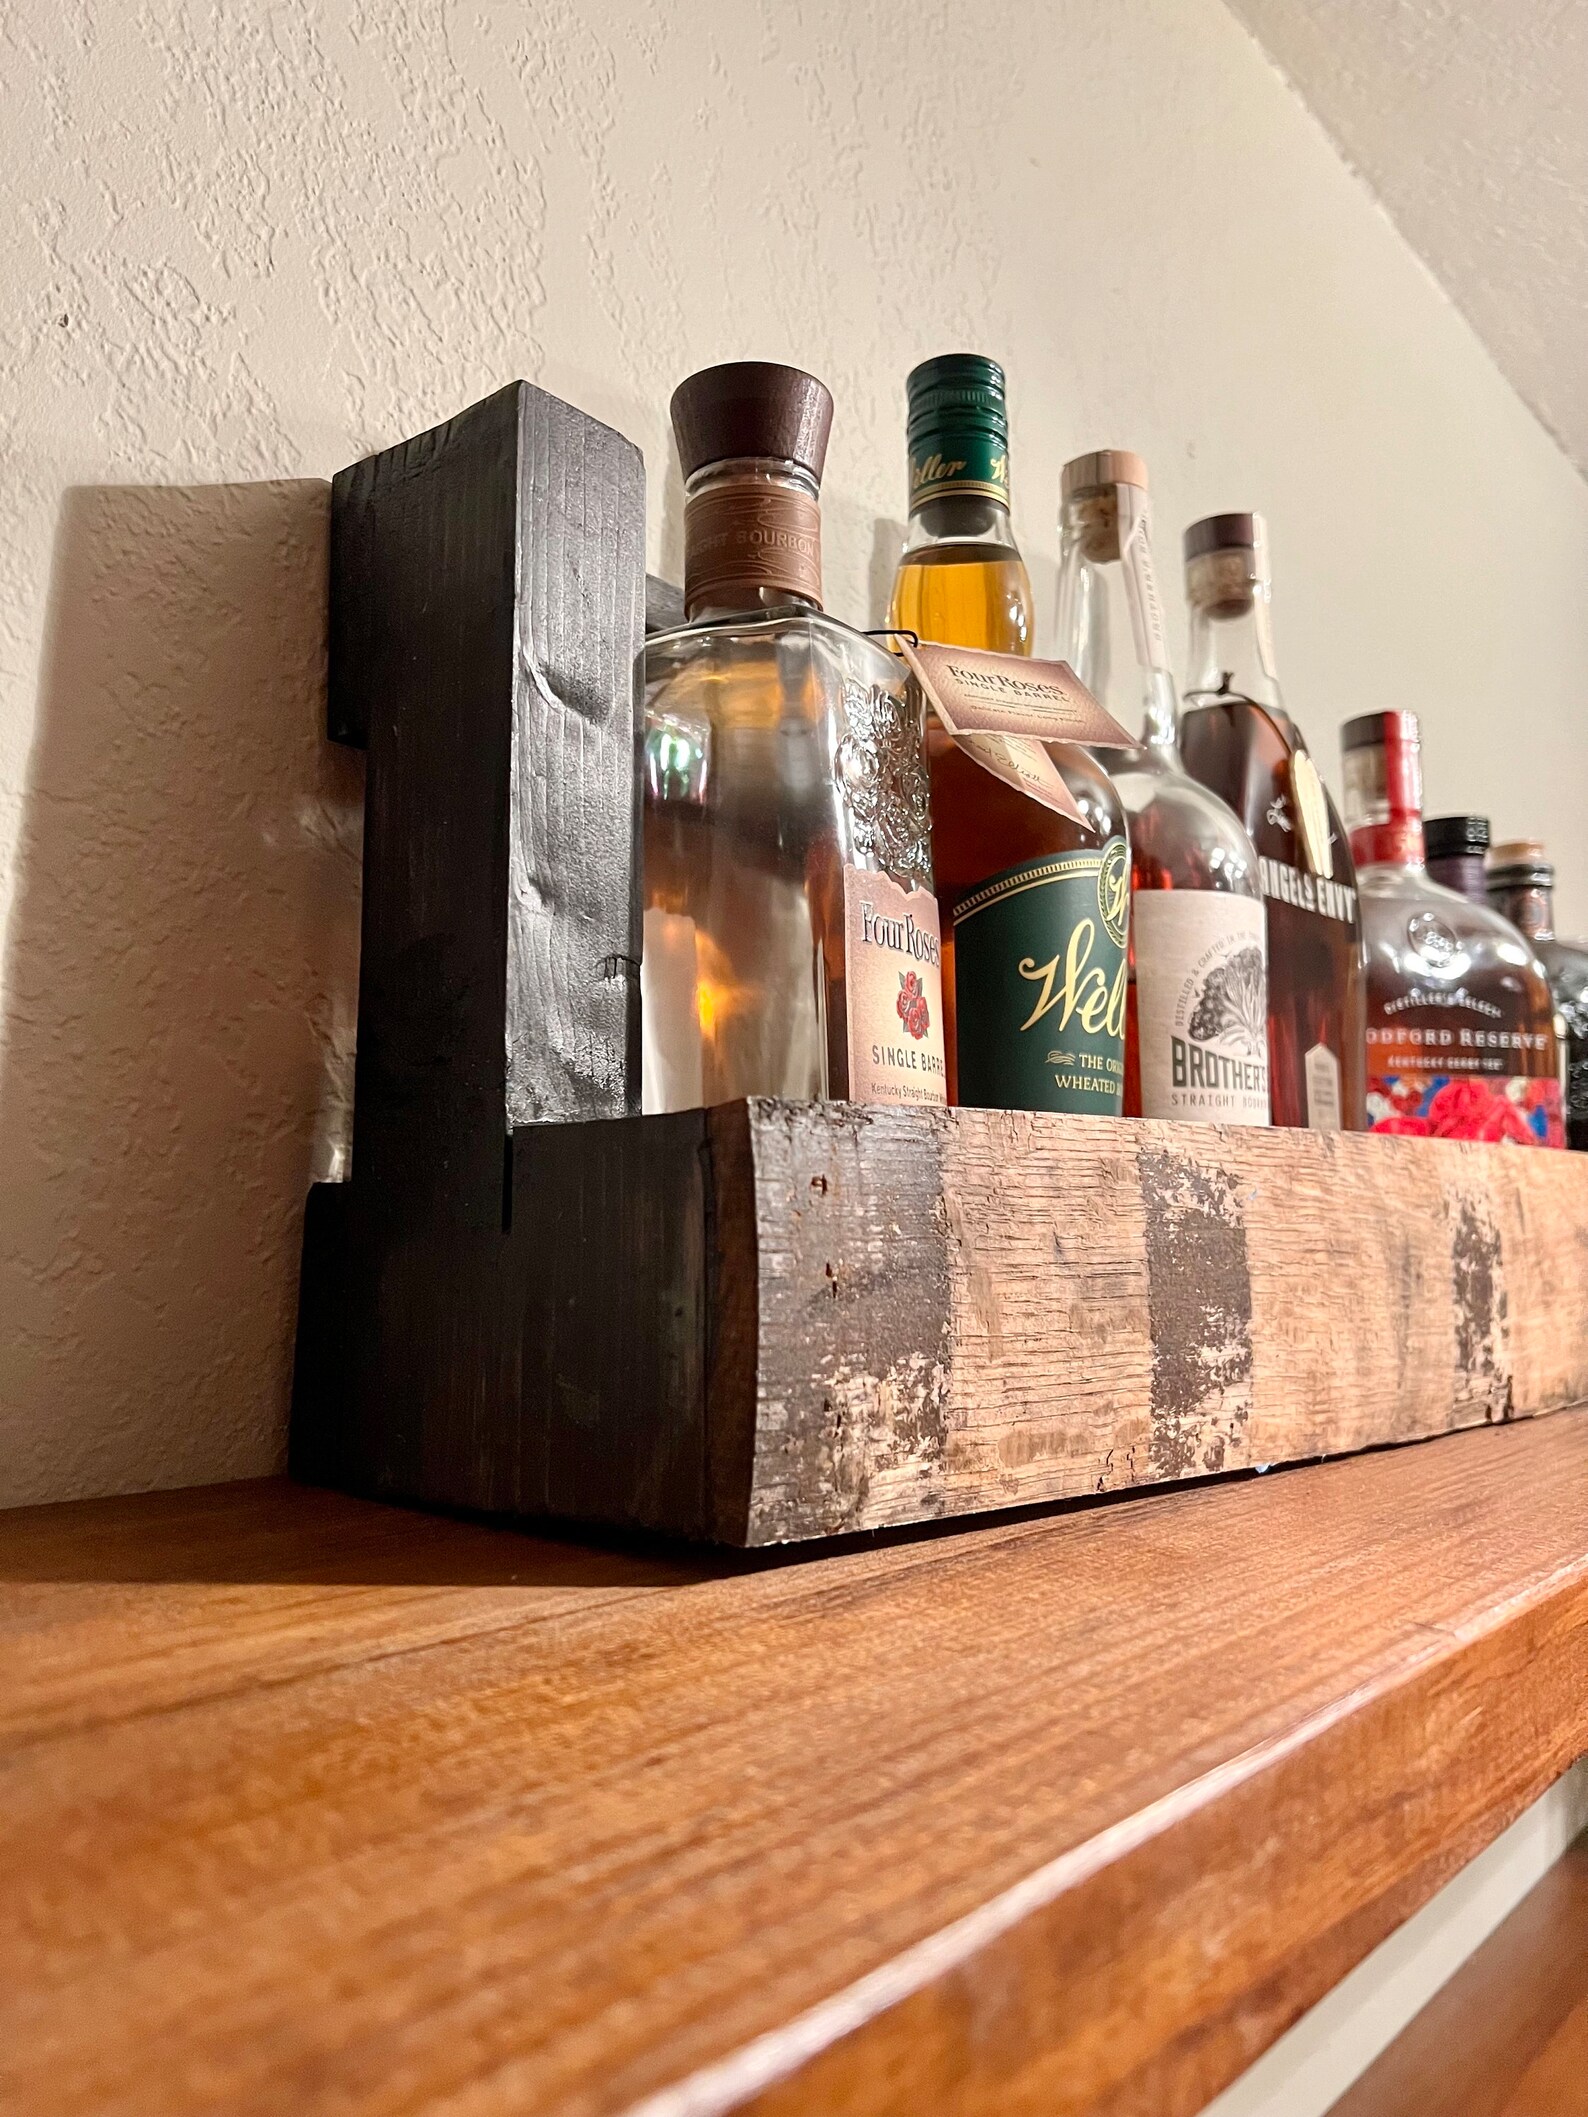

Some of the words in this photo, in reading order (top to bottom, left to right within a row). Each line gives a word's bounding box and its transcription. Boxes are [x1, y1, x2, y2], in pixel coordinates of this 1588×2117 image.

[736, 529, 815, 557] BOURBON
[955, 678, 1007, 694] SINGLE
[1014, 690, 1070, 703] BARREL
[1174, 978, 1194, 1027] DISTILLED
[1198, 937, 1225, 968] CRAFTED
[1366, 1027, 1453, 1046] ODFORD
[872, 1044, 917, 1070] SINGLE
[1079, 1053, 1103, 1071] THE
[871, 1083, 902, 1099] Kentucky
[903, 1085, 922, 1101] Straight
[1055, 1074, 1115, 1095] WHEATED
[1171, 1093, 1235, 1107] STRAIGHT
